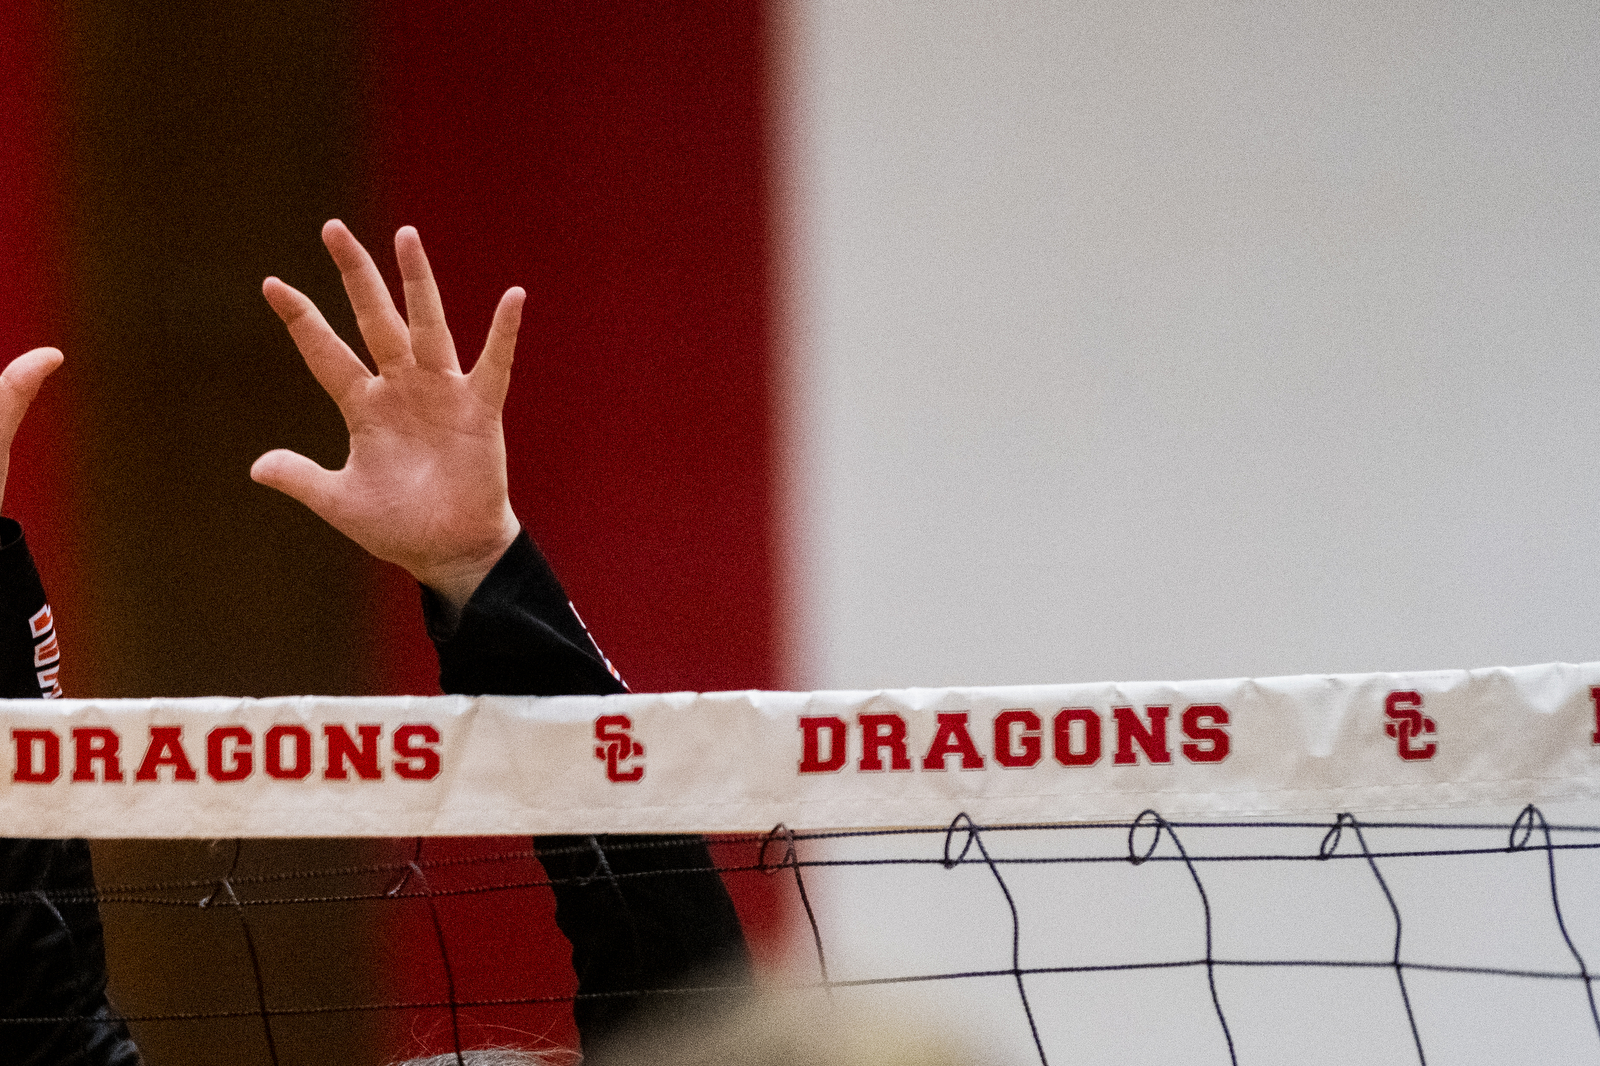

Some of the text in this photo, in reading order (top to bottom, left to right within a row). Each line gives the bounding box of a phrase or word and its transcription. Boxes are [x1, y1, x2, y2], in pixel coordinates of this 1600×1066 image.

[9, 722, 443, 786] DRAGONS
[593, 713, 646, 784] SC
[797, 702, 1233, 776] DRAGONS
[1383, 689, 1439, 763] SC
